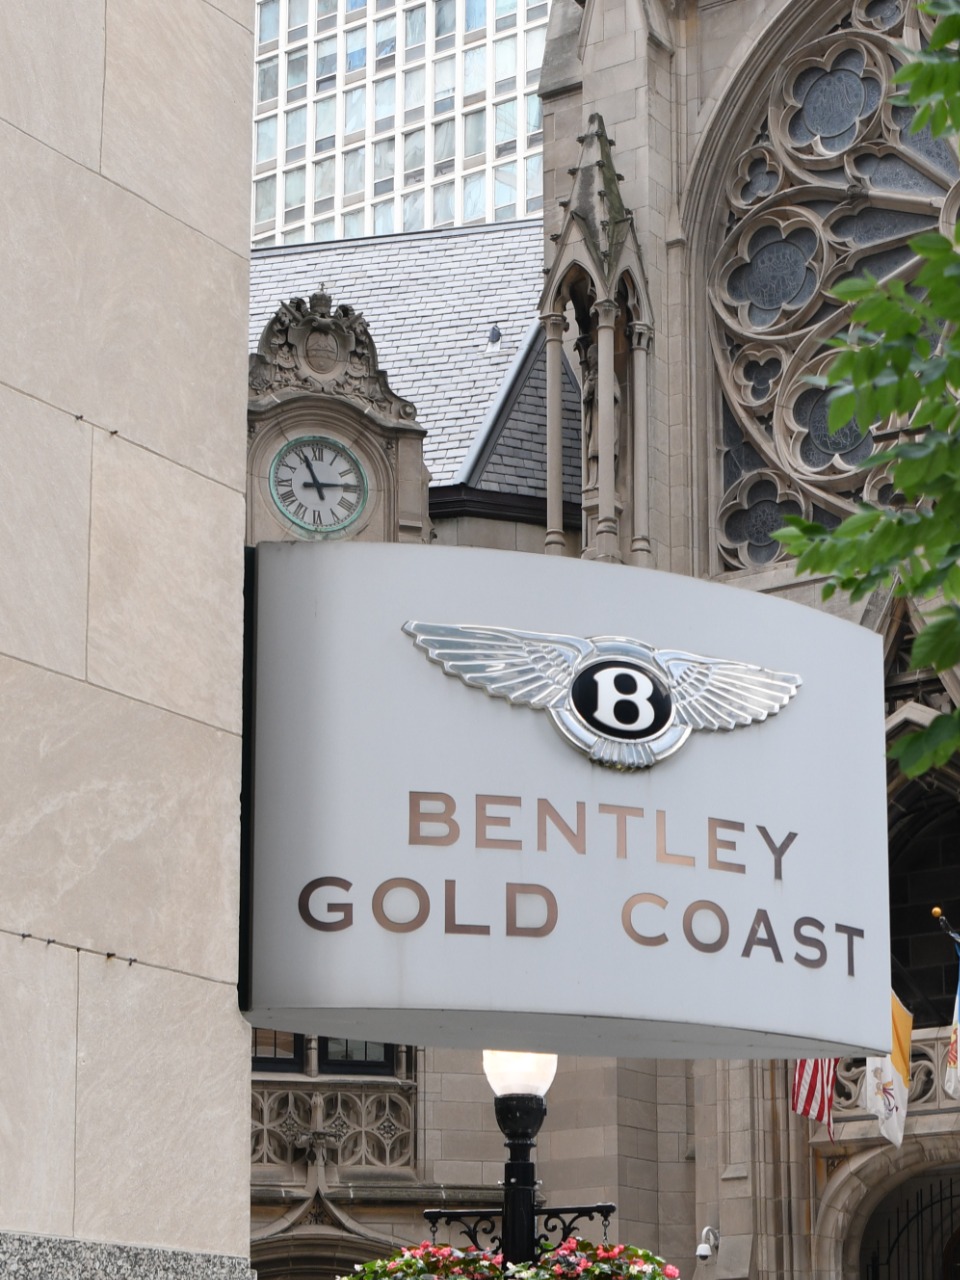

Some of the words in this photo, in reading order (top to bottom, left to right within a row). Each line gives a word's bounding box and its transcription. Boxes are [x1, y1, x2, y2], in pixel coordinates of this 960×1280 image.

[592, 666, 654, 732] B
[408, 791, 798, 880] BENTLEY
[298, 876, 558, 938] GOLD
[622, 892, 865, 976] COAST
